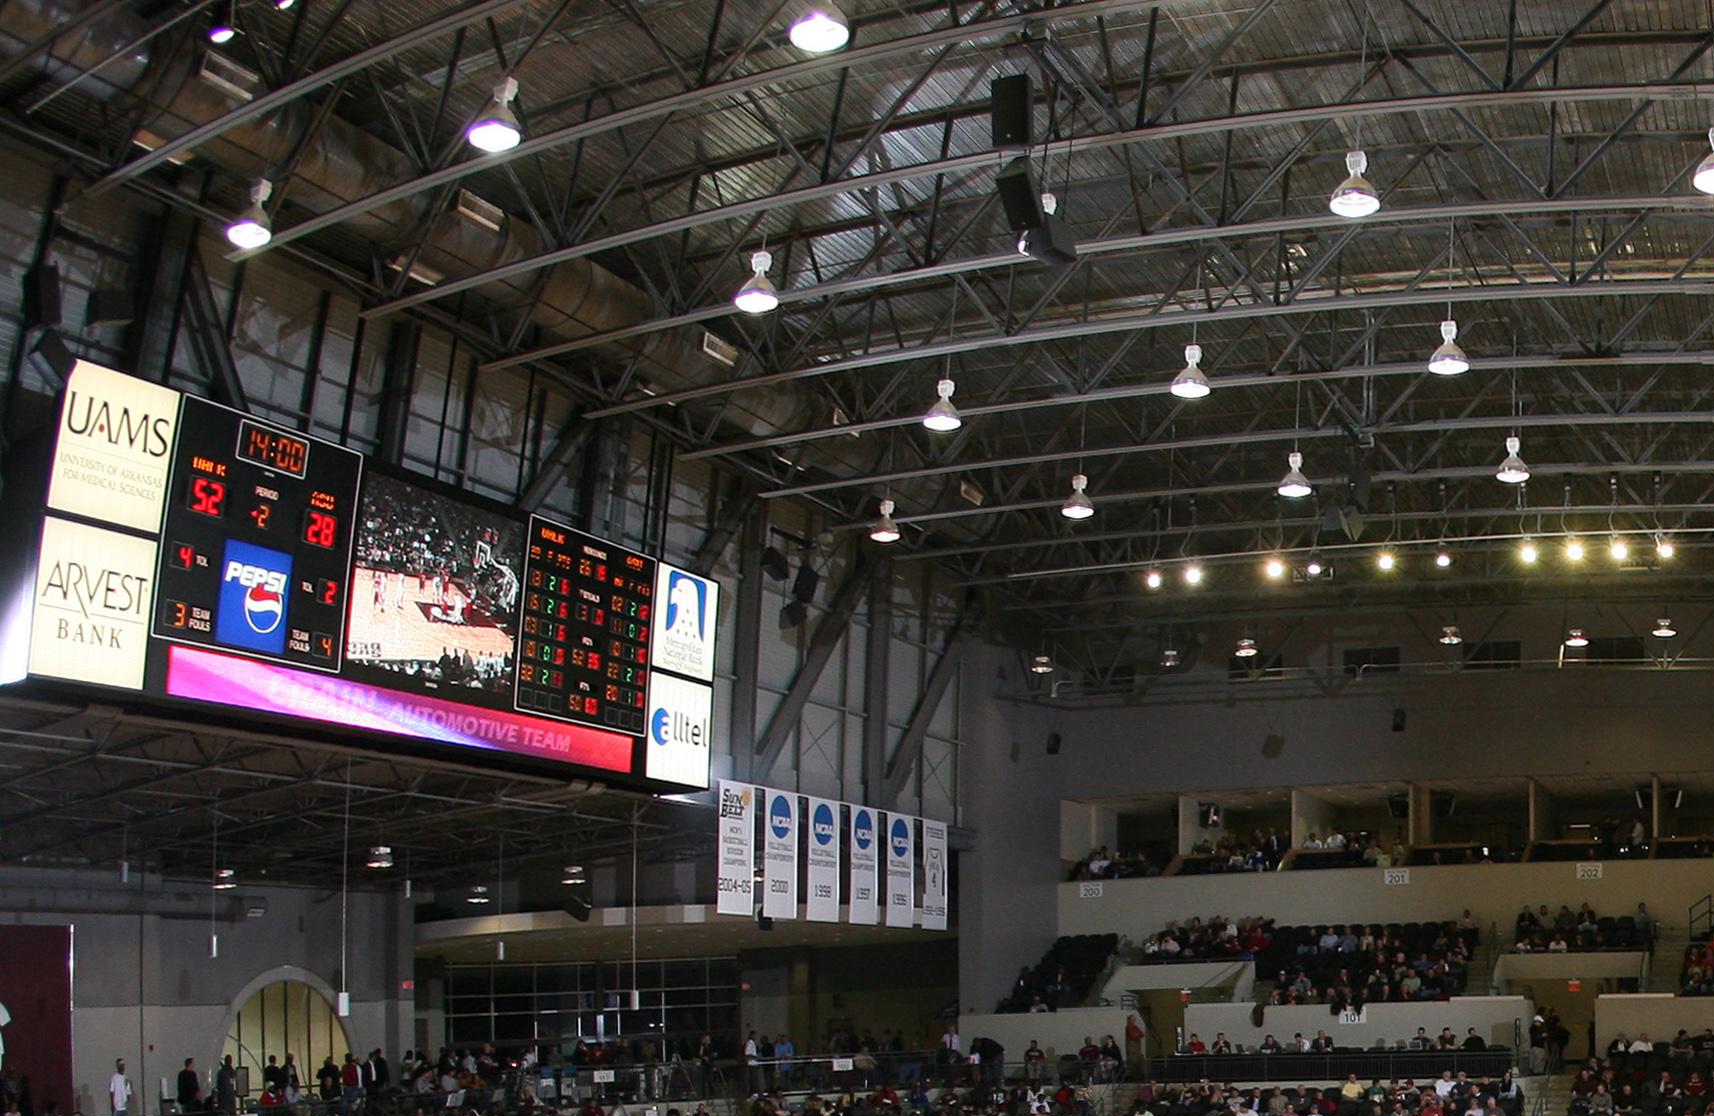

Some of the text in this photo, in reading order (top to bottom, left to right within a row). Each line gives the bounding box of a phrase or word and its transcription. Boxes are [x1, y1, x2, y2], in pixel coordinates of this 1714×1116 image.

[68, 391, 168, 457] UAMS
[249, 430, 304, 471] 14:00
[192, 478, 225, 515] 52
[255, 486, 279, 500] PERIOD
[307, 512, 336, 547] 28
[179, 547, 193, 569] 4
[225, 561, 287, 594] PEPSI
[41, 559, 147, 619] ARVEST
[325, 581, 337, 604] 2
[174, 603, 186, 628] 3
[57, 617, 122, 649] BANK
[322, 638, 332, 656] 4
[391, 703, 571, 752] AUTOMOTIVE TEAM
[653, 708, 707, 748] alltel
[722, 789, 744, 805] SUN
[720, 803, 744, 817] BELT
[1388, 874, 1405, 884] 201
[1580, 869, 1598, 878] 202
[719, 877, 751, 894] 2004-05
[771, 879, 788, 893] 2000
[1083, 887, 1100, 897] 200
[1345, 1013, 1361, 1022] 101
